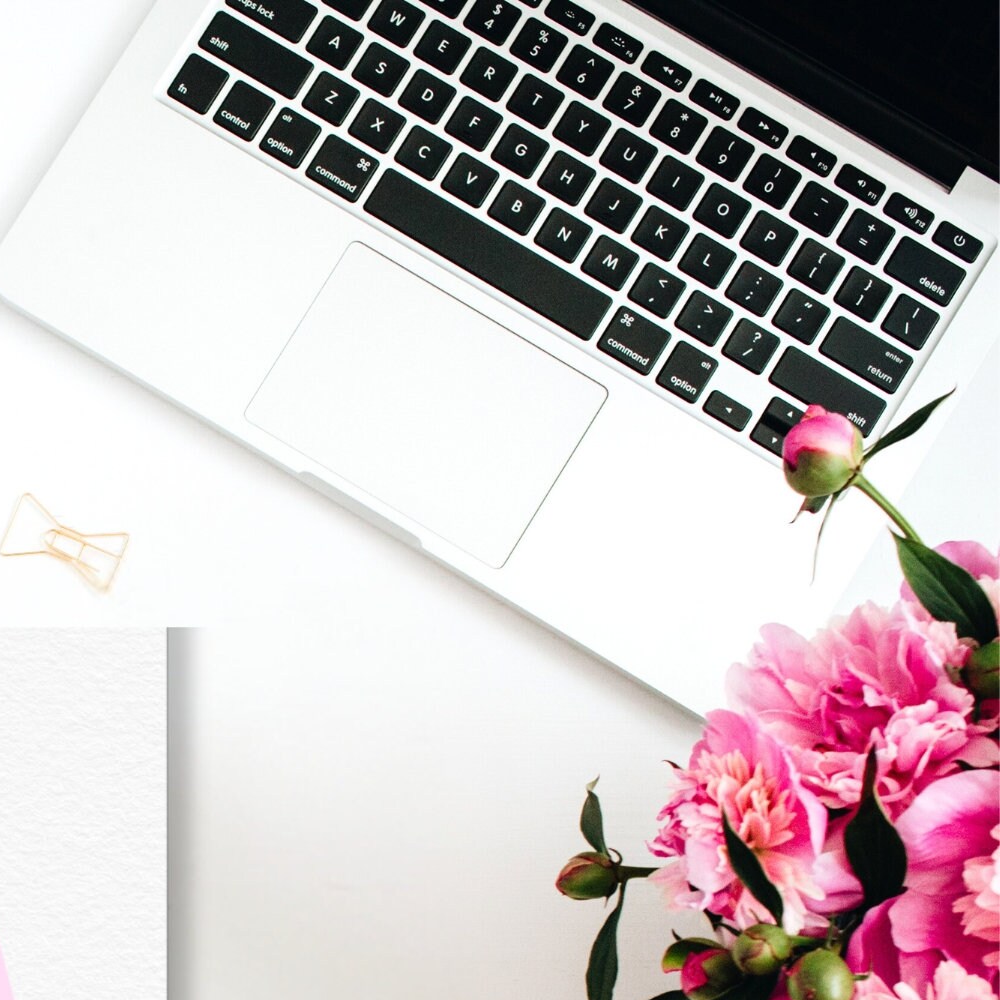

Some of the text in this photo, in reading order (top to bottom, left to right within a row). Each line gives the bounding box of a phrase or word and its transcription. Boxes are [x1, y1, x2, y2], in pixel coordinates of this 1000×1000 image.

[257, 4, 275, 20] lock
[389, 10, 406, 27] W
[483, 18, 495, 30] 4
[209, 35, 229, 51] shift
[328, 35, 341, 50] A
[437, 39, 450, 53] E
[529, 44, 541, 57] 5
[374, 61, 388, 75] S
[483, 65, 496, 81] R
[576, 72, 587, 84] 6
[177, 83, 188, 95] fn
[421, 87, 434, 102] D
[324, 89, 339, 105] Z
[532, 92, 543, 106] T
[623, 98, 635, 110] 7
[221, 108, 250, 131] control
[281, 114, 293, 123] alt
[369, 117, 385, 133] X
[468, 115, 481, 128] F
[578, 119, 590, 133] Y
[670, 126, 681, 138] 8
[267, 136, 293, 156] option
[418, 145, 431, 159] C
[514, 143, 528, 157] G
[623, 147, 637, 162] U
[717, 153, 728, 165] 9
[315, 164, 357, 193] command
[466, 171, 479, 185] V
[559, 169, 575, 185] H
[510, 199, 523, 213] B
[608, 199, 620, 211] J
[556, 226, 572, 242] N
[654, 224, 669, 240] K
[763, 230, 777, 242] P
[601, 253, 619, 271] M
[702, 252, 711, 267] L
[919, 275, 945, 296] delete
[607, 336, 649, 366] command
[885, 350, 904, 364] enter
[700, 361, 712, 371] alt
[867, 364, 893, 383] return
[670, 374, 697, 395] option
[847, 411, 866, 427] shift
